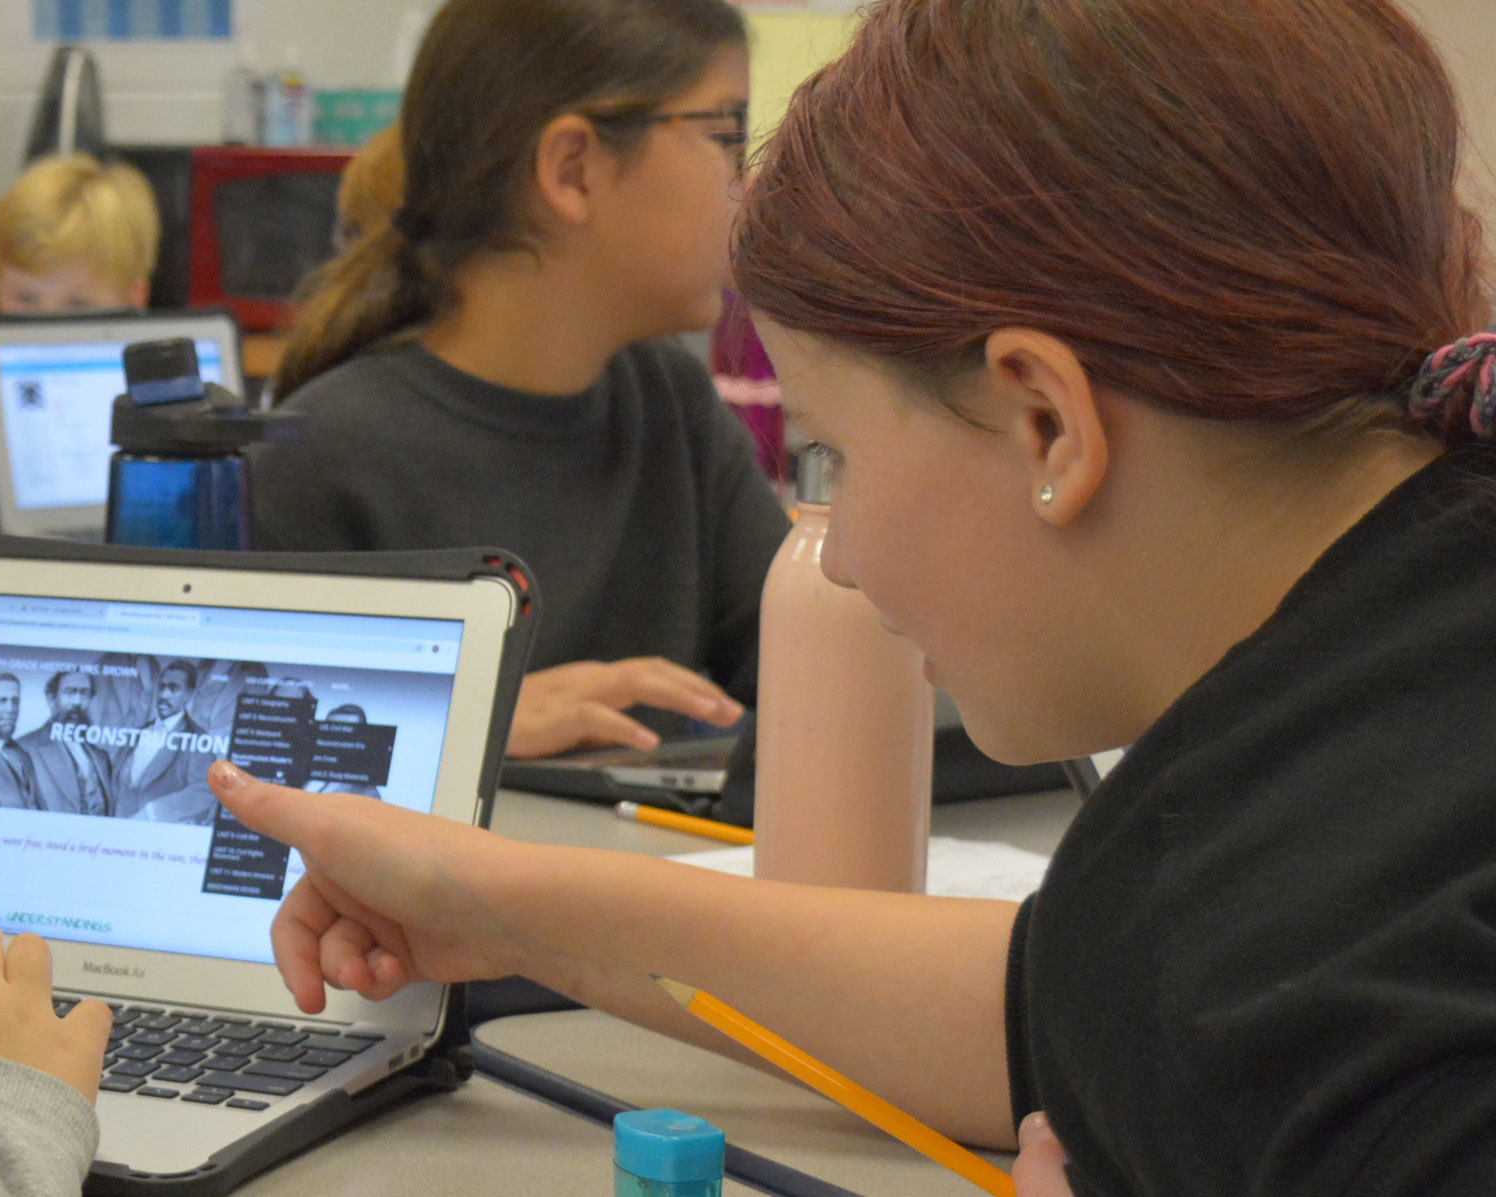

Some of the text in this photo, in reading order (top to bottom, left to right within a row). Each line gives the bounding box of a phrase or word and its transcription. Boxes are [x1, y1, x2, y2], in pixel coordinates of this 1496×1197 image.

[8, 658, 38, 671] GRADE
[39, 661, 79, 674] HISTORY
[103, 666, 138, 678] BROWN
[50, 722, 229, 754] RECONSTRUCTION
[6, 911, 112, 932] UNDERSTANDINGS
[82, 961, 146, 978] MacBook Air
